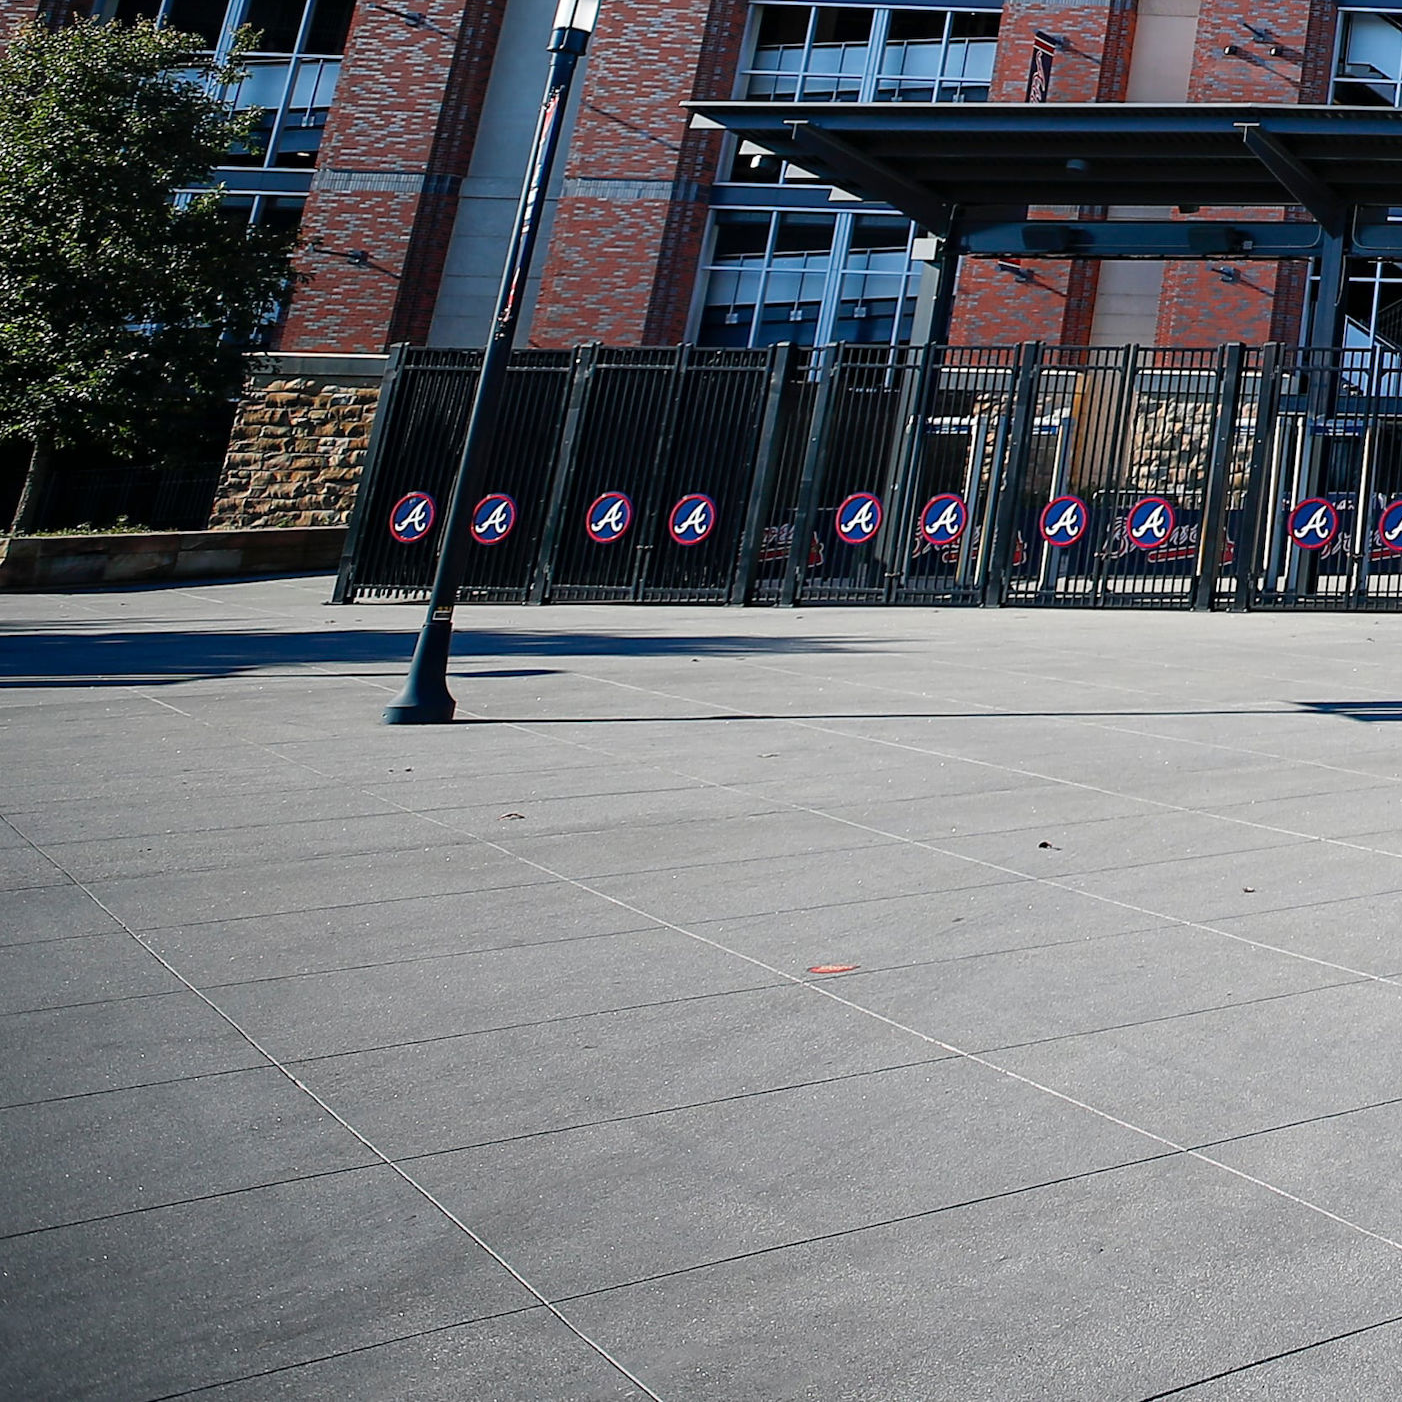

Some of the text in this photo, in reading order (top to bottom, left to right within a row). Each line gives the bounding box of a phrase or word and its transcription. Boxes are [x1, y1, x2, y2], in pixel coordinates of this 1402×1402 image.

[394, 500, 426, 532] A
[476, 501, 508, 534] A
[591, 500, 623, 532] A
[674, 502, 707, 535] A
[840, 500, 874, 533] A
[925, 502, 959, 535] A
[1045, 503, 1079, 537] A
[1132, 505, 1166, 538] A
[1294, 506, 1329, 539] A
